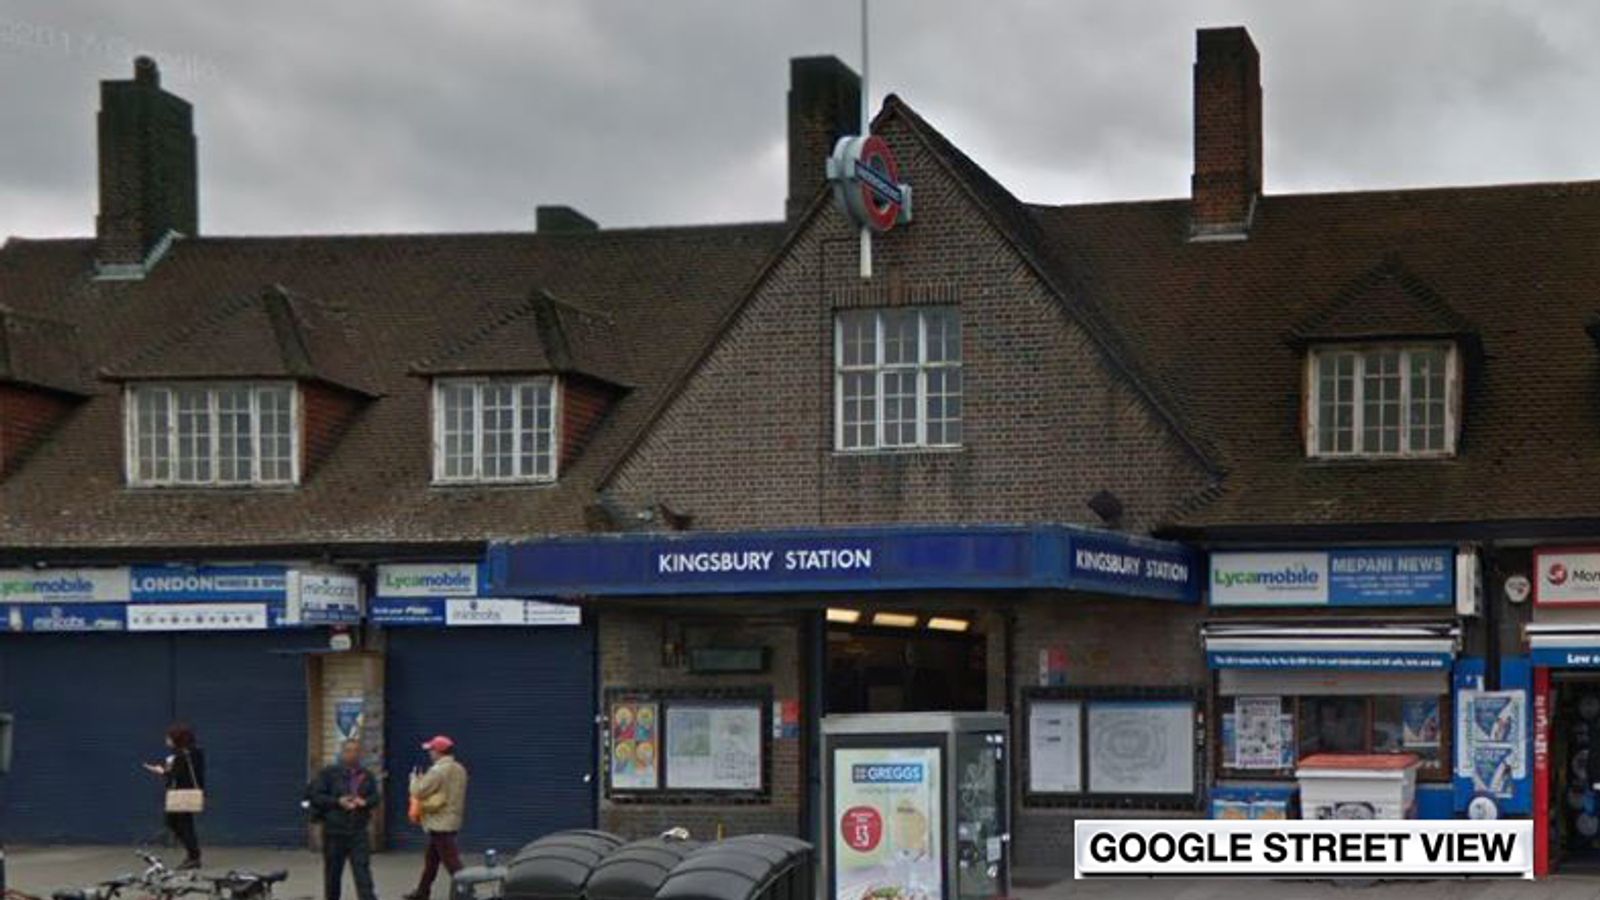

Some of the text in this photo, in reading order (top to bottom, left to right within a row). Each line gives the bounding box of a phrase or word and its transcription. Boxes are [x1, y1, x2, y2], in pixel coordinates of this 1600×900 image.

[658, 548, 872, 573] KINGSBURY STATION
[1075, 549, 1190, 583] KINGSBURY STATION
[1331, 555, 1444, 573] MEPANI NEWS
[131, 576, 214, 592] LONDON
[384, 570, 472, 590] Lycamobile
[1214, 563, 1319, 588] Lycamobile
[868, 766, 920, 780] GREGGS
